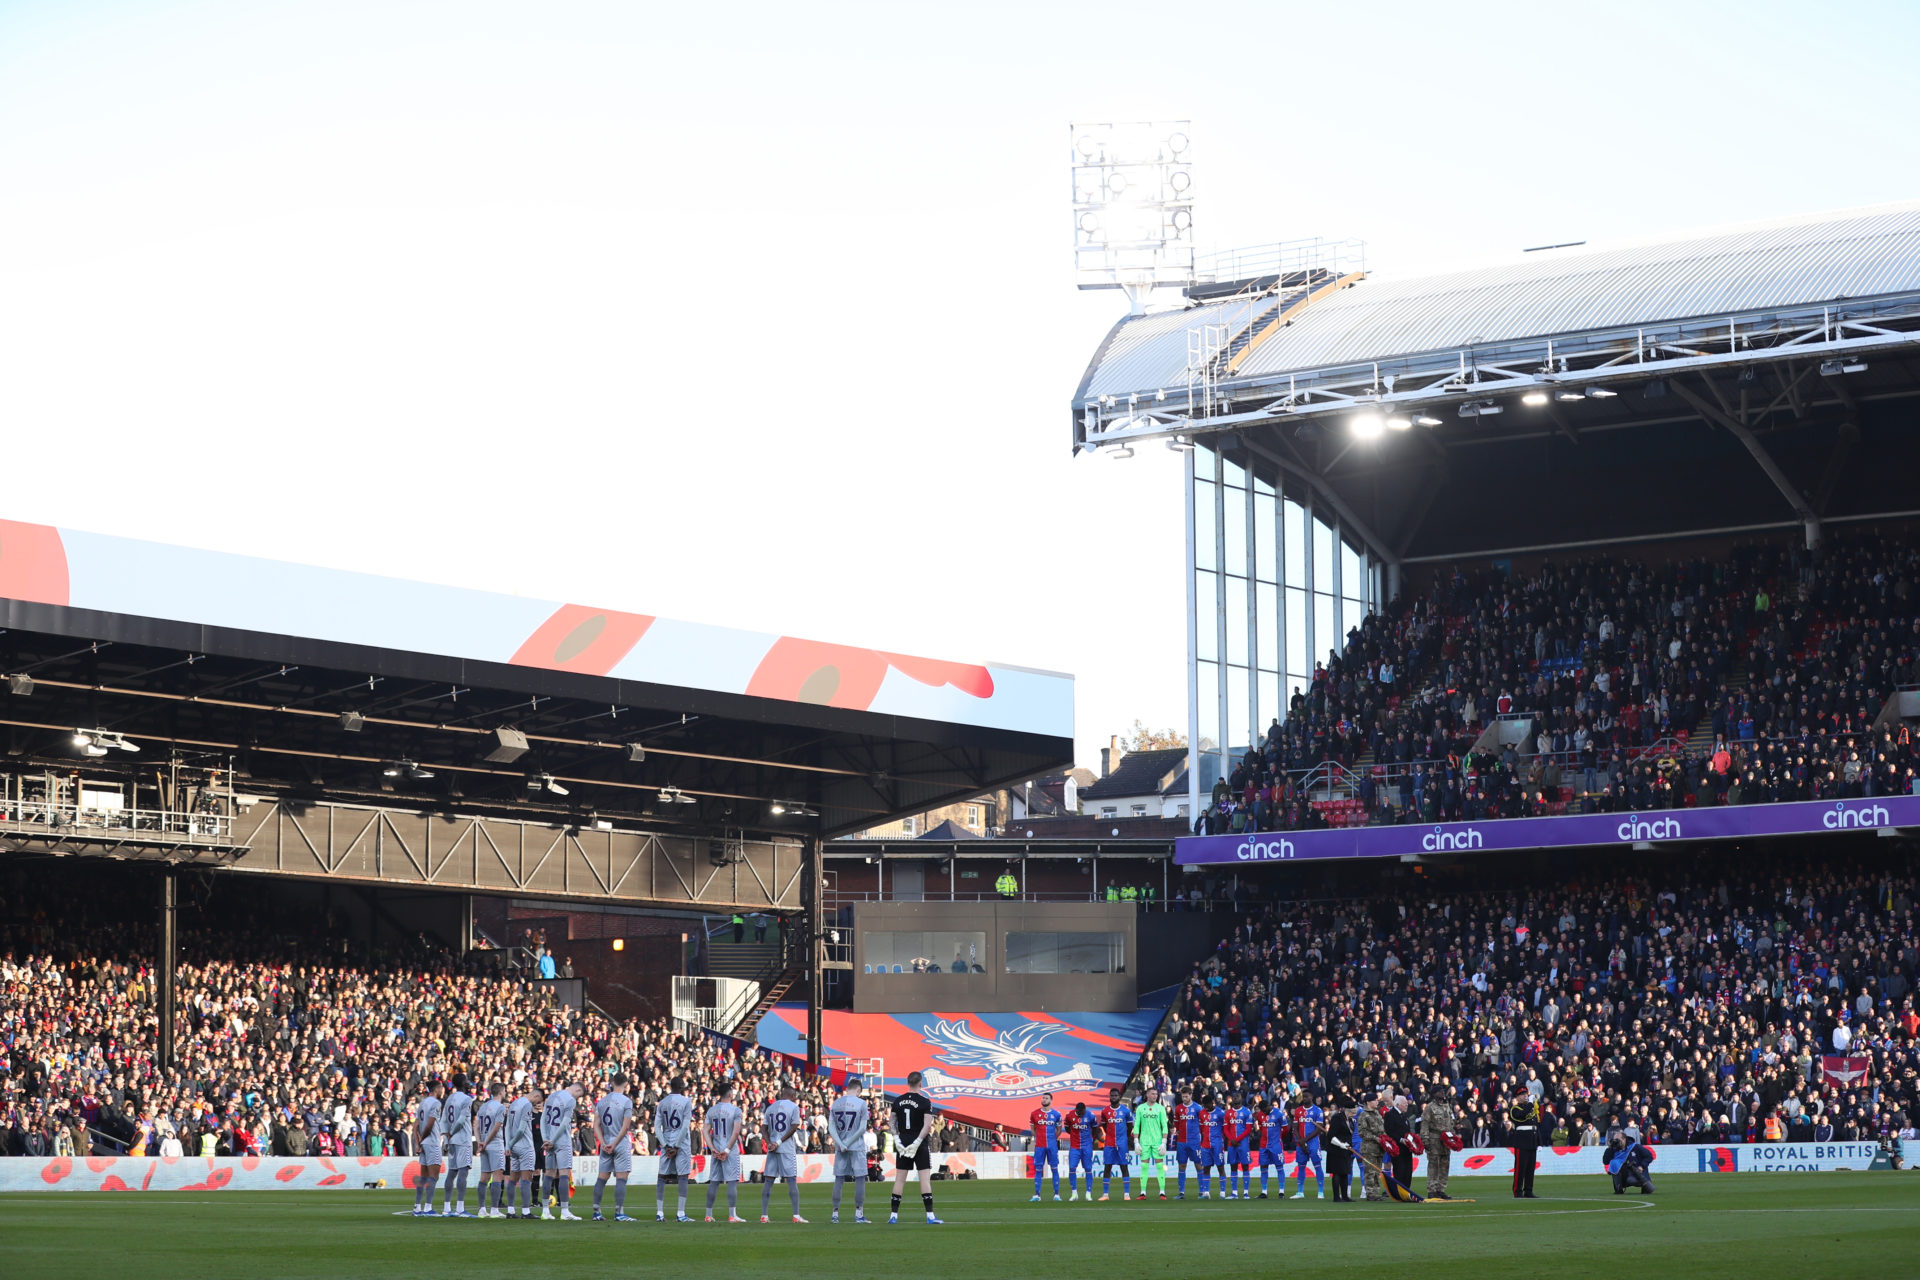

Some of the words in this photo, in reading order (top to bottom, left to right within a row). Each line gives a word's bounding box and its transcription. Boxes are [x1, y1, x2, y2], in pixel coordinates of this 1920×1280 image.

[1823, 802, 1889, 829] cinch
[1618, 815, 1681, 840] cinch
[1237, 836, 1294, 859] cinch
[1422, 826, 1482, 850] cinch
[933, 1086, 1001, 1096] CRYSTAL
[1005, 1082, 1063, 1096] PALACE
[448, 1105, 455, 1123] 8
[510, 1110, 516, 1127] 7
[546, 1105, 561, 1127] 32
[602, 1106, 613, 1127] 6
[663, 1109, 681, 1129] 16
[769, 1112, 787, 1133] 18
[834, 1111, 857, 1131] 37
[904, 1108, 911, 1130] 1
[1037, 1118, 1055, 1126] cinch
[479, 1115, 492, 1134] 19
[712, 1118, 727, 1138] 11
[1753, 1147, 1809, 1160] ROYAL
